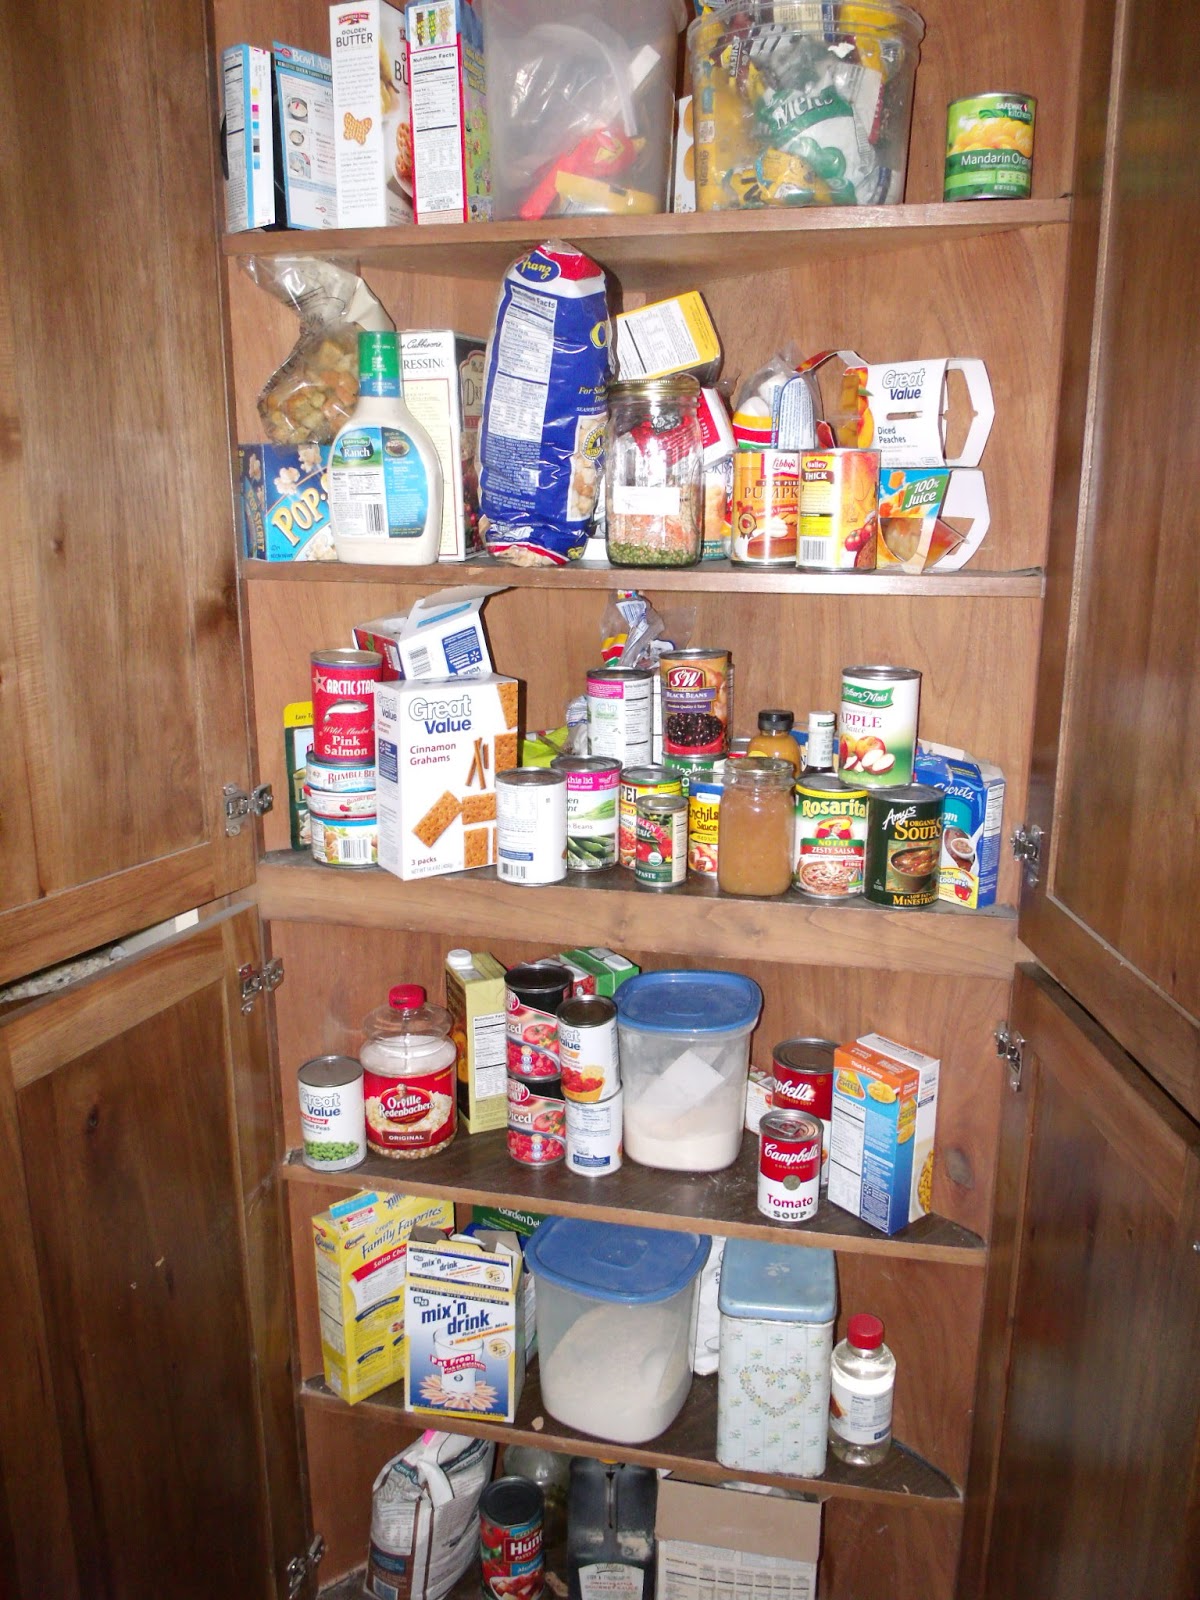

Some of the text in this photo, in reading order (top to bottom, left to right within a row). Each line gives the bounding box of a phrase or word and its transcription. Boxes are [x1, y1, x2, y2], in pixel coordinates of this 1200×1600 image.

[342, 27, 367, 35] GOLDEN
[336, 33, 373, 47] BUTTER
[292, 49, 315, 67] Bowl
[961, 152, 1011, 166] Mandarin
[536, 297, 556, 309] Facts
[882, 367, 926, 390] Great
[578, 386, 593, 395] For
[890, 387, 922, 401] Value
[877, 426, 897, 435] Diced
[879, 436, 907, 444] Peaches
[344, 447, 371, 458] Ranch
[773, 457, 796, 470] Libby's
[807, 460, 828, 469] Nalley
[805, 471, 828, 480] THICK
[905, 491, 937, 509] Juice
[271, 487, 324, 548] POP
[326, 679, 357, 695] ARCTIC
[666, 691, 685, 699] BLACK
[381, 706, 398, 722] Value
[408, 694, 472, 722] Great
[424, 717, 472, 735] Value
[841, 712, 882, 729] APPLE
[332, 735, 360, 746] Pink
[324, 744, 368, 757] Salmon
[410, 743, 457, 755] Cinnamon
[410, 754, 451, 766] Grahams
[327, 770, 362, 785] BUMBLE
[802, 798, 867, 818] Rosarita
[882, 806, 917, 830] Amy's
[811, 846, 855, 854] ZESTY SALSA
[417, 856, 437, 867] packs
[300, 1087, 341, 1108] Great
[386, 1094, 422, 1110] Orville
[307, 1105, 341, 1117] Value
[767, 1193, 813, 1209] Tomato
[773, 1210, 807, 1220] SOUP
[361, 1206, 443, 1260] Family Favorites
[373, 1255, 391, 1269] Salsa
[440, 1261, 458, 1271] drink
[447, 1309, 490, 1336] drink
